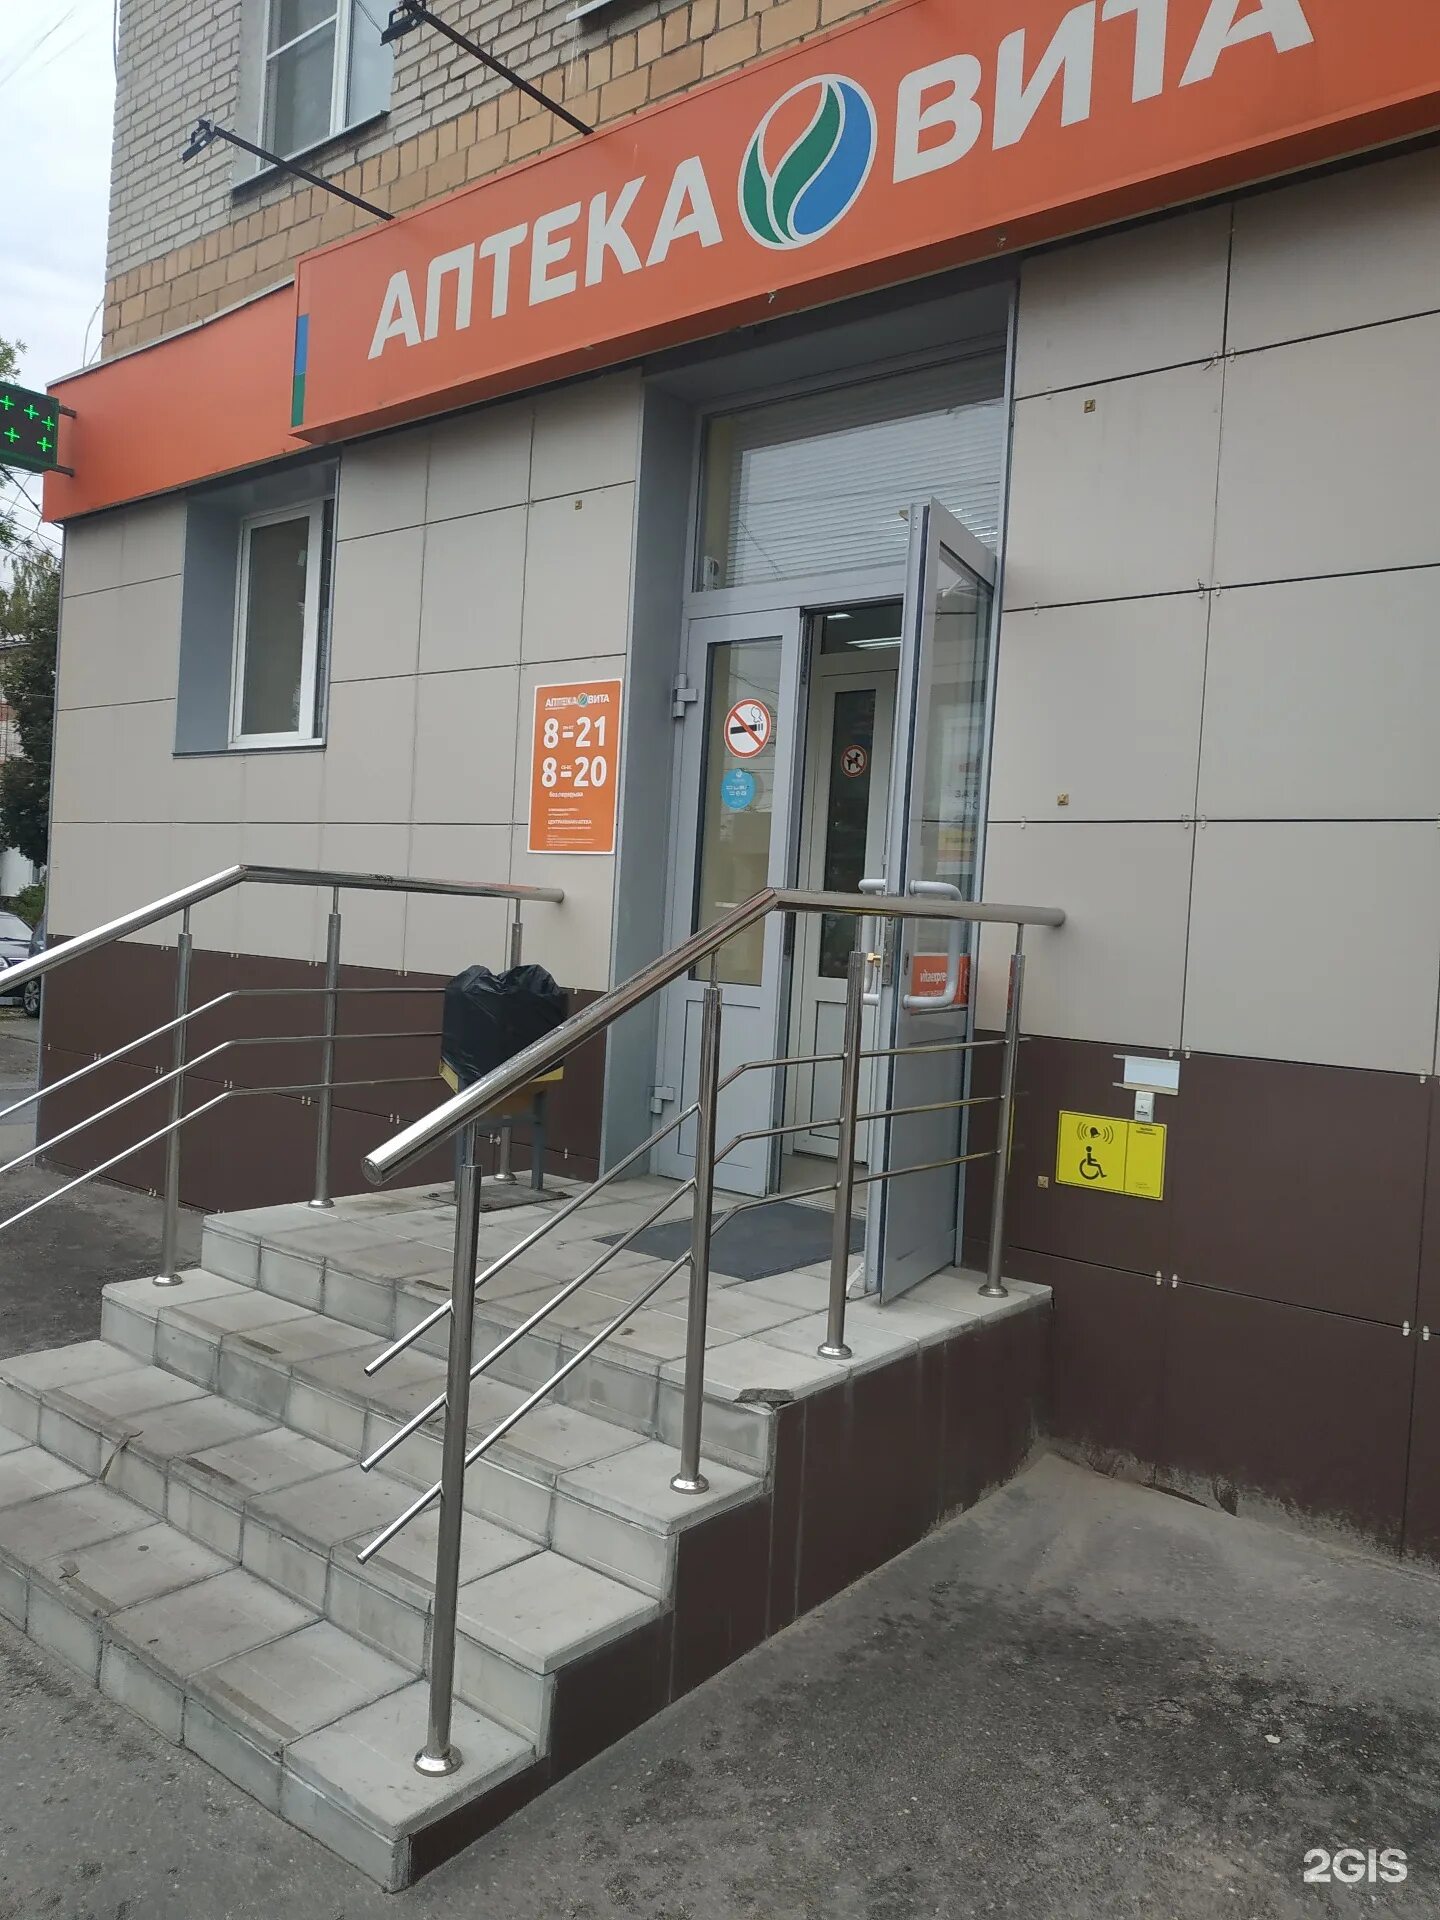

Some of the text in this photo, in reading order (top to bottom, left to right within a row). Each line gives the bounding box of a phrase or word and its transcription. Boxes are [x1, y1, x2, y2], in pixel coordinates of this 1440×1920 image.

[368, 0, 1314, 360] АПТЕКА ВИТА
[545, 694, 610, 708] АПТЕКА ВИТА
